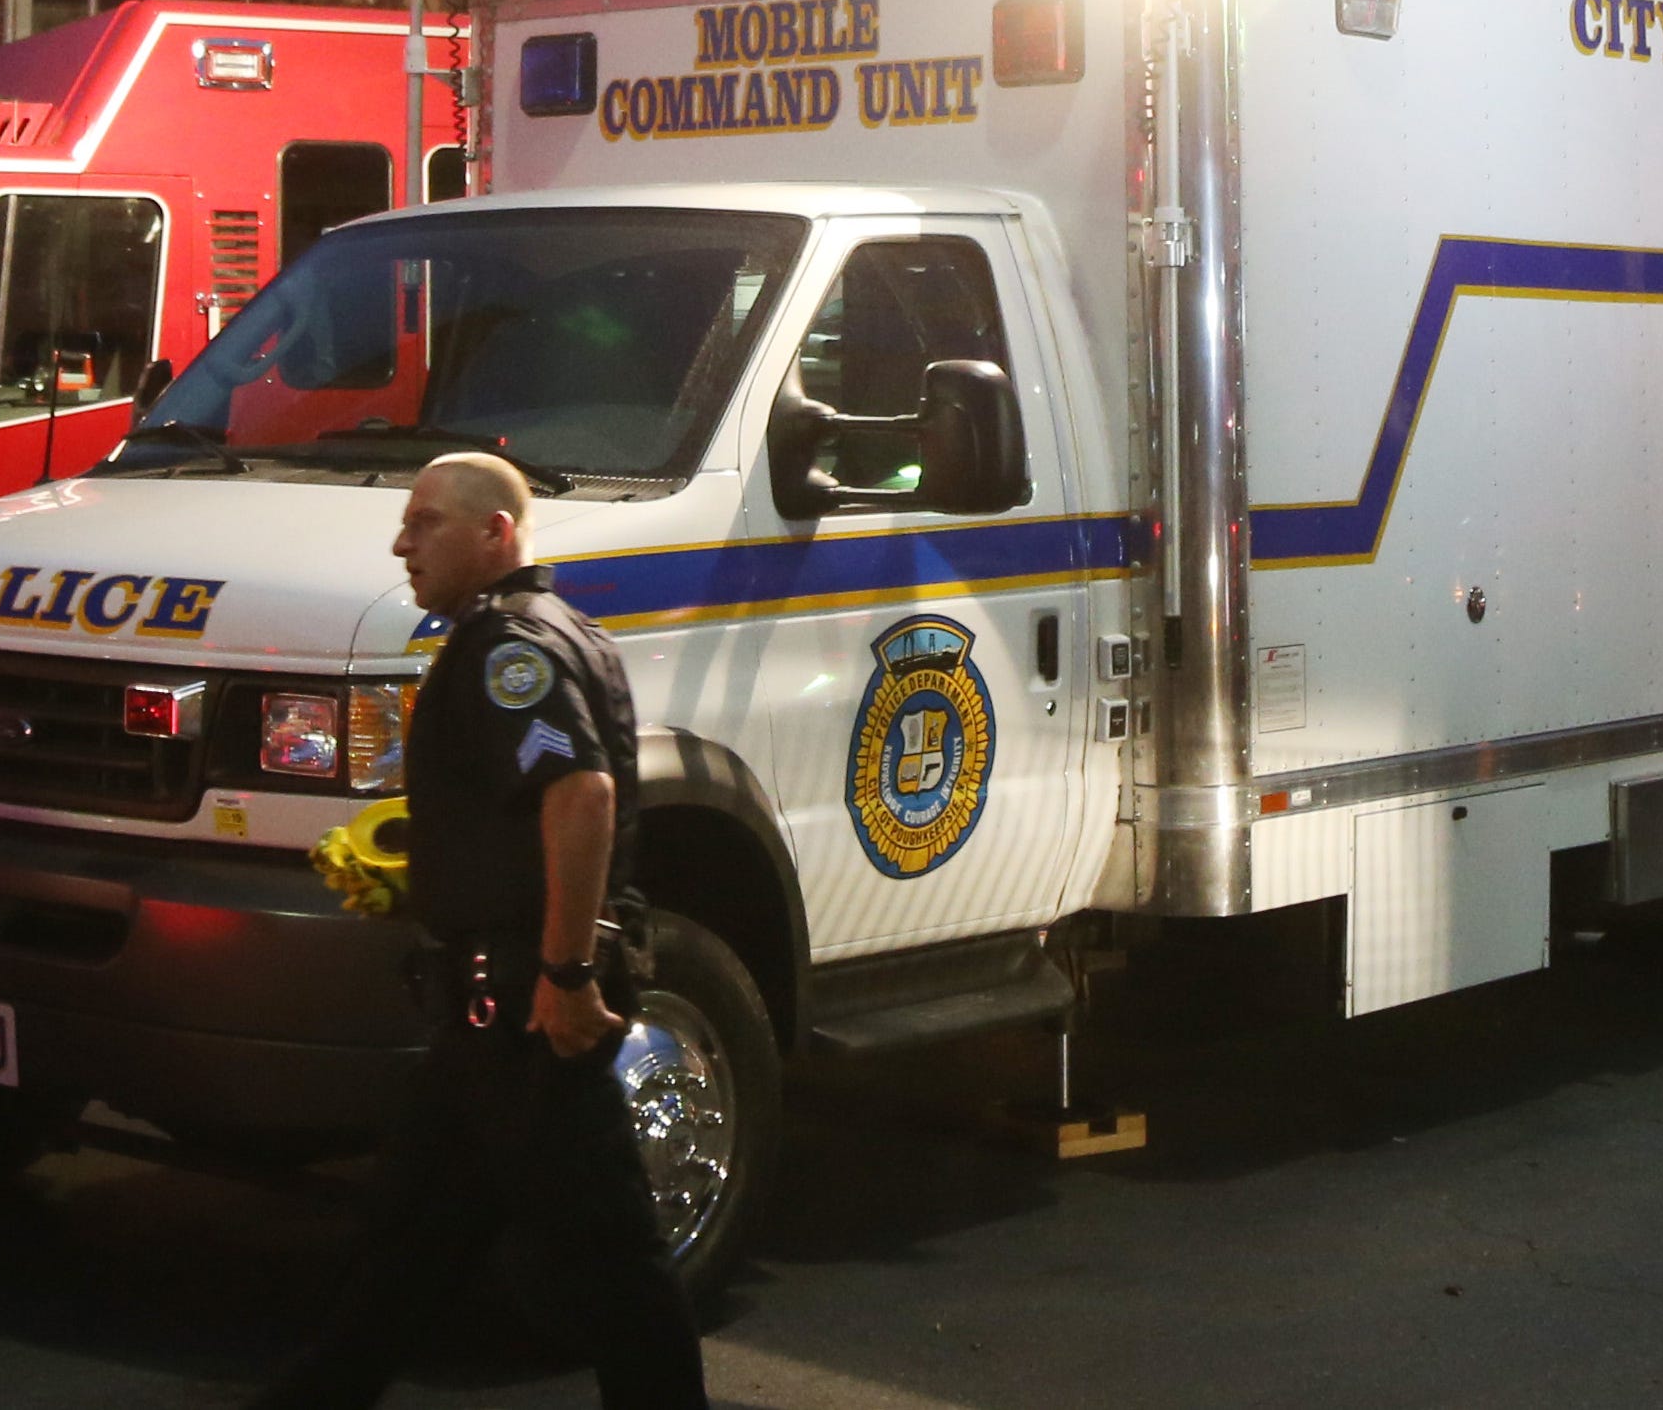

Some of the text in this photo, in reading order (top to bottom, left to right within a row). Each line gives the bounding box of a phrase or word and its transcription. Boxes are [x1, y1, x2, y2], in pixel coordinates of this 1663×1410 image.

[600, 54, 984, 143] COMMAND UNIT
[875, 673, 973, 740] POLICE DEPARTMENT
[868, 778, 883, 808] CITY
[880, 811, 893, 826] OF
[904, 800, 942, 824] COURAGE
